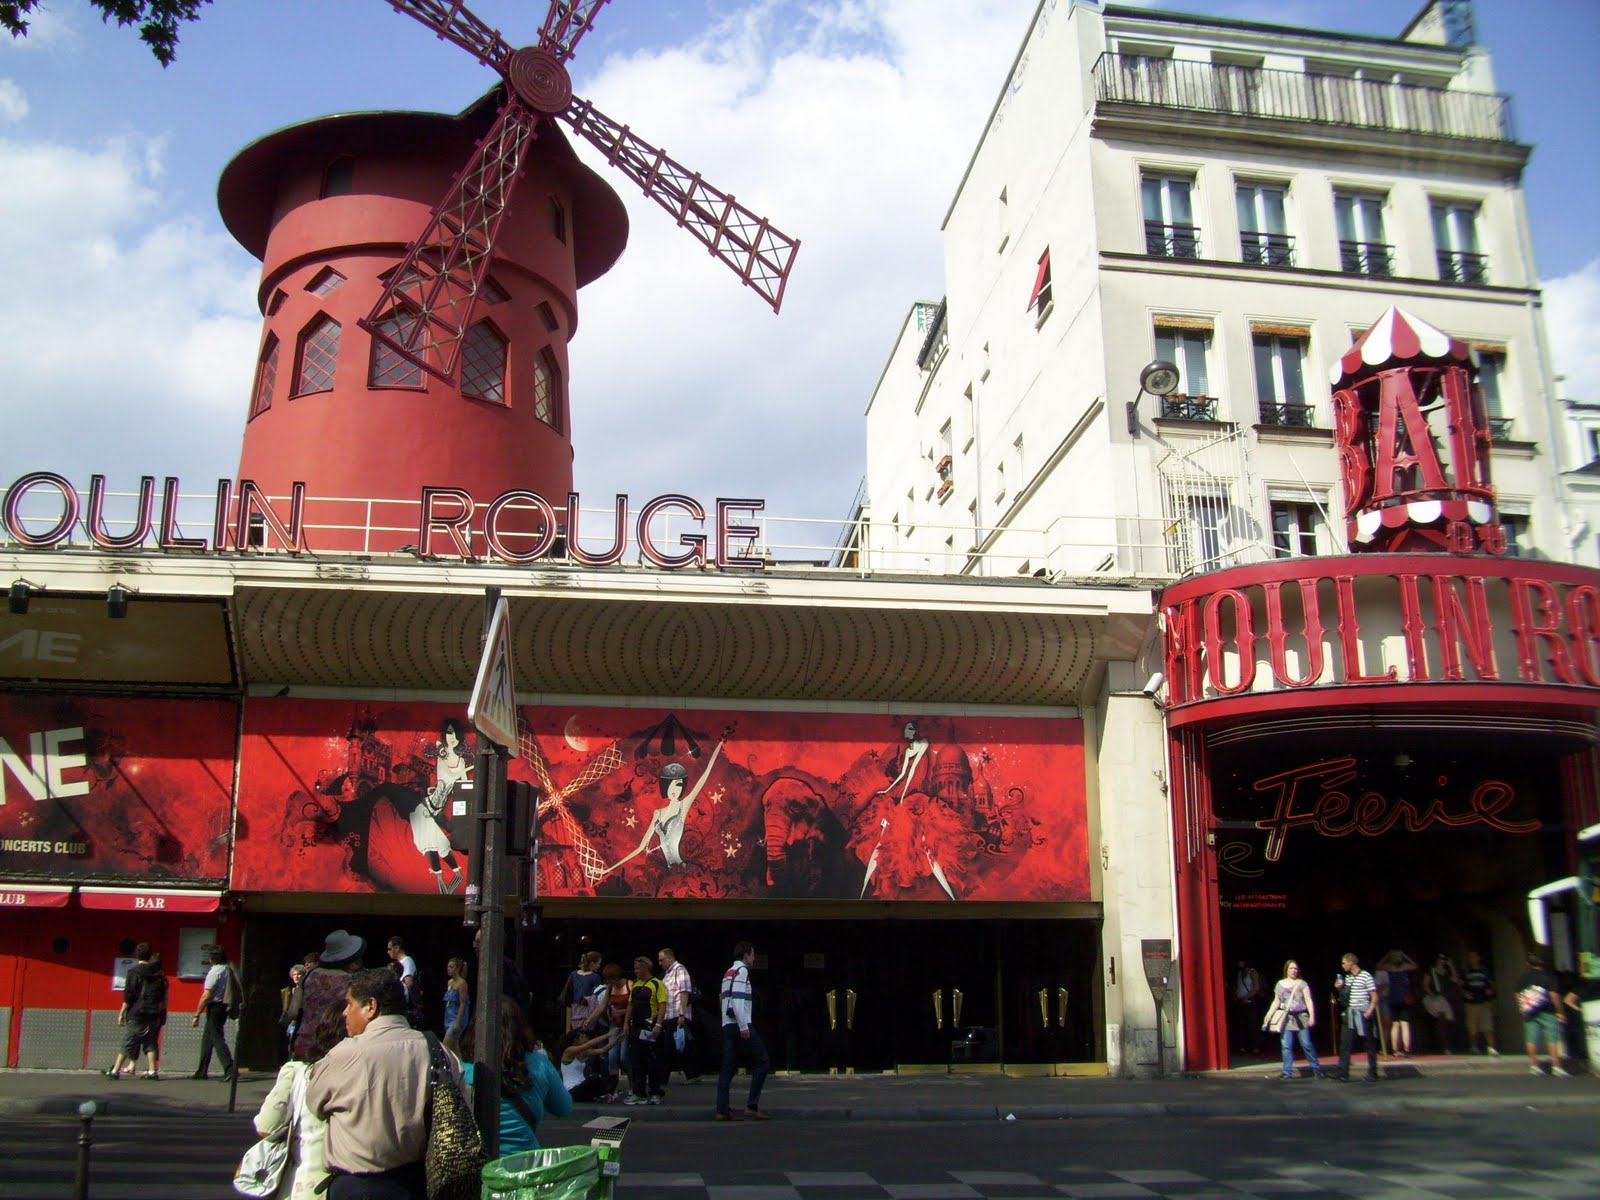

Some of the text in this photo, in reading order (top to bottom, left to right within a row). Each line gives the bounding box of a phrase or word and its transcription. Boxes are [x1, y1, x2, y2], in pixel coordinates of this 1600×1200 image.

[418, 486, 765, 570] ROUGE
[1162, 574, 1500, 707] MOULIN
[0, 727, 90, 805] NE
[55, 841, 87, 854] CLUB
[134, 897, 165, 909] BAR
